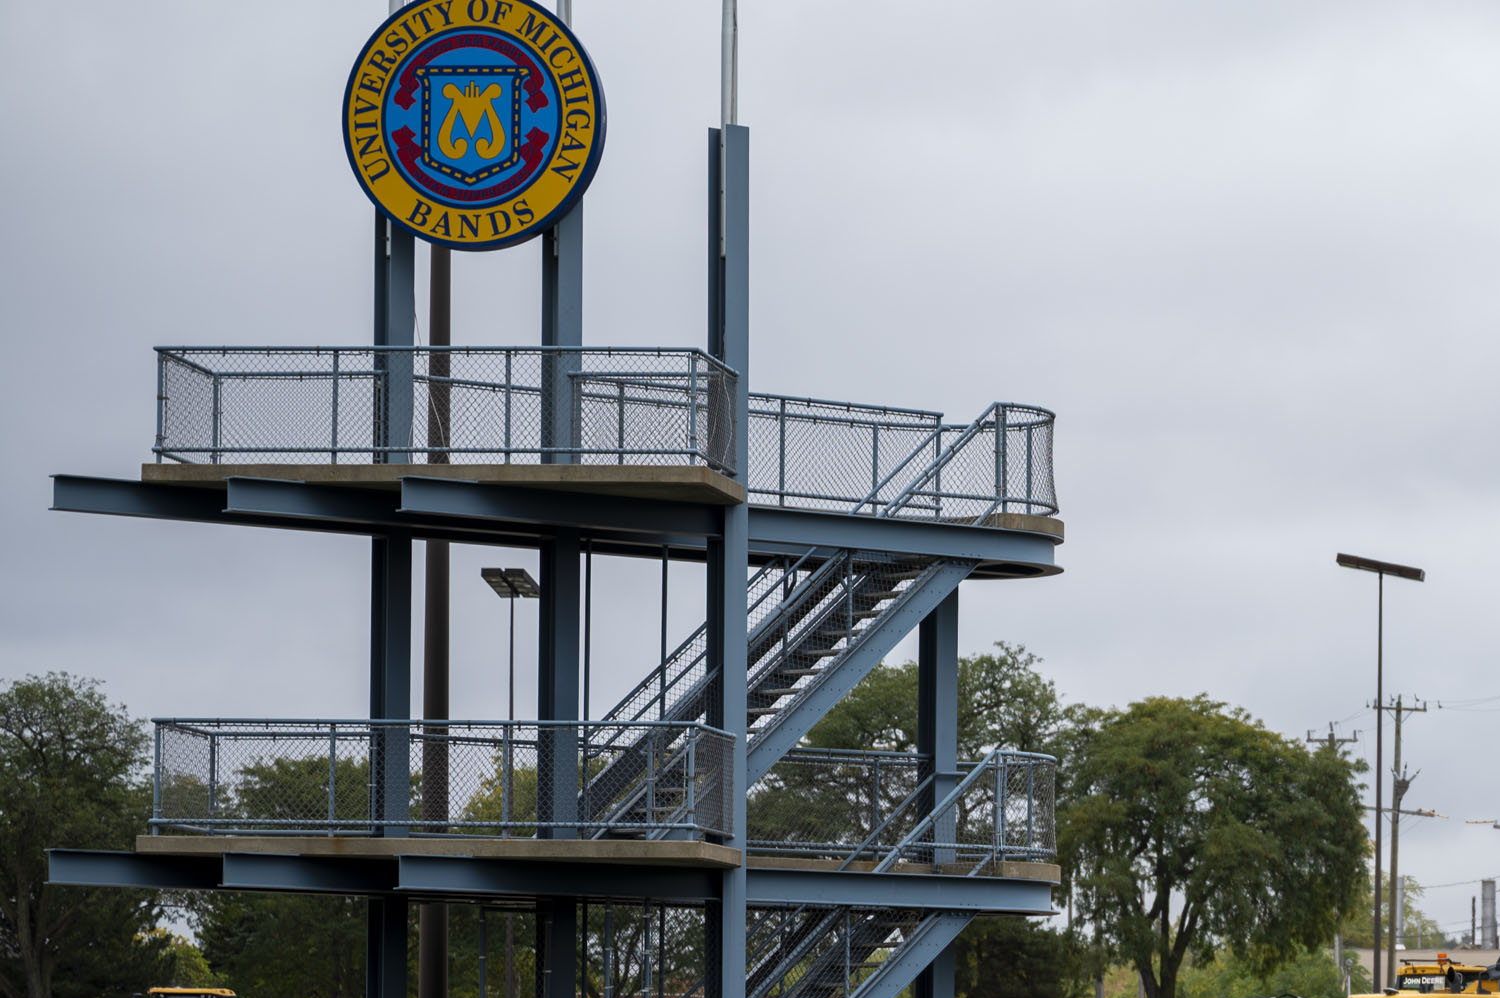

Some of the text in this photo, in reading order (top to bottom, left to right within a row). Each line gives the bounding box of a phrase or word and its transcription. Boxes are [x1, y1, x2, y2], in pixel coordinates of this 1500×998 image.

[423, 39, 453, 61] NON
[456, 35, 483, 46] TAM
[354, 0, 592, 185] UNIVERSITY OF MICHIGAN
[413, 168, 451, 196] QUAM
[404, 197, 535, 240] BANDS
[1403, 976, 1445, 985] JOHN DEERE
